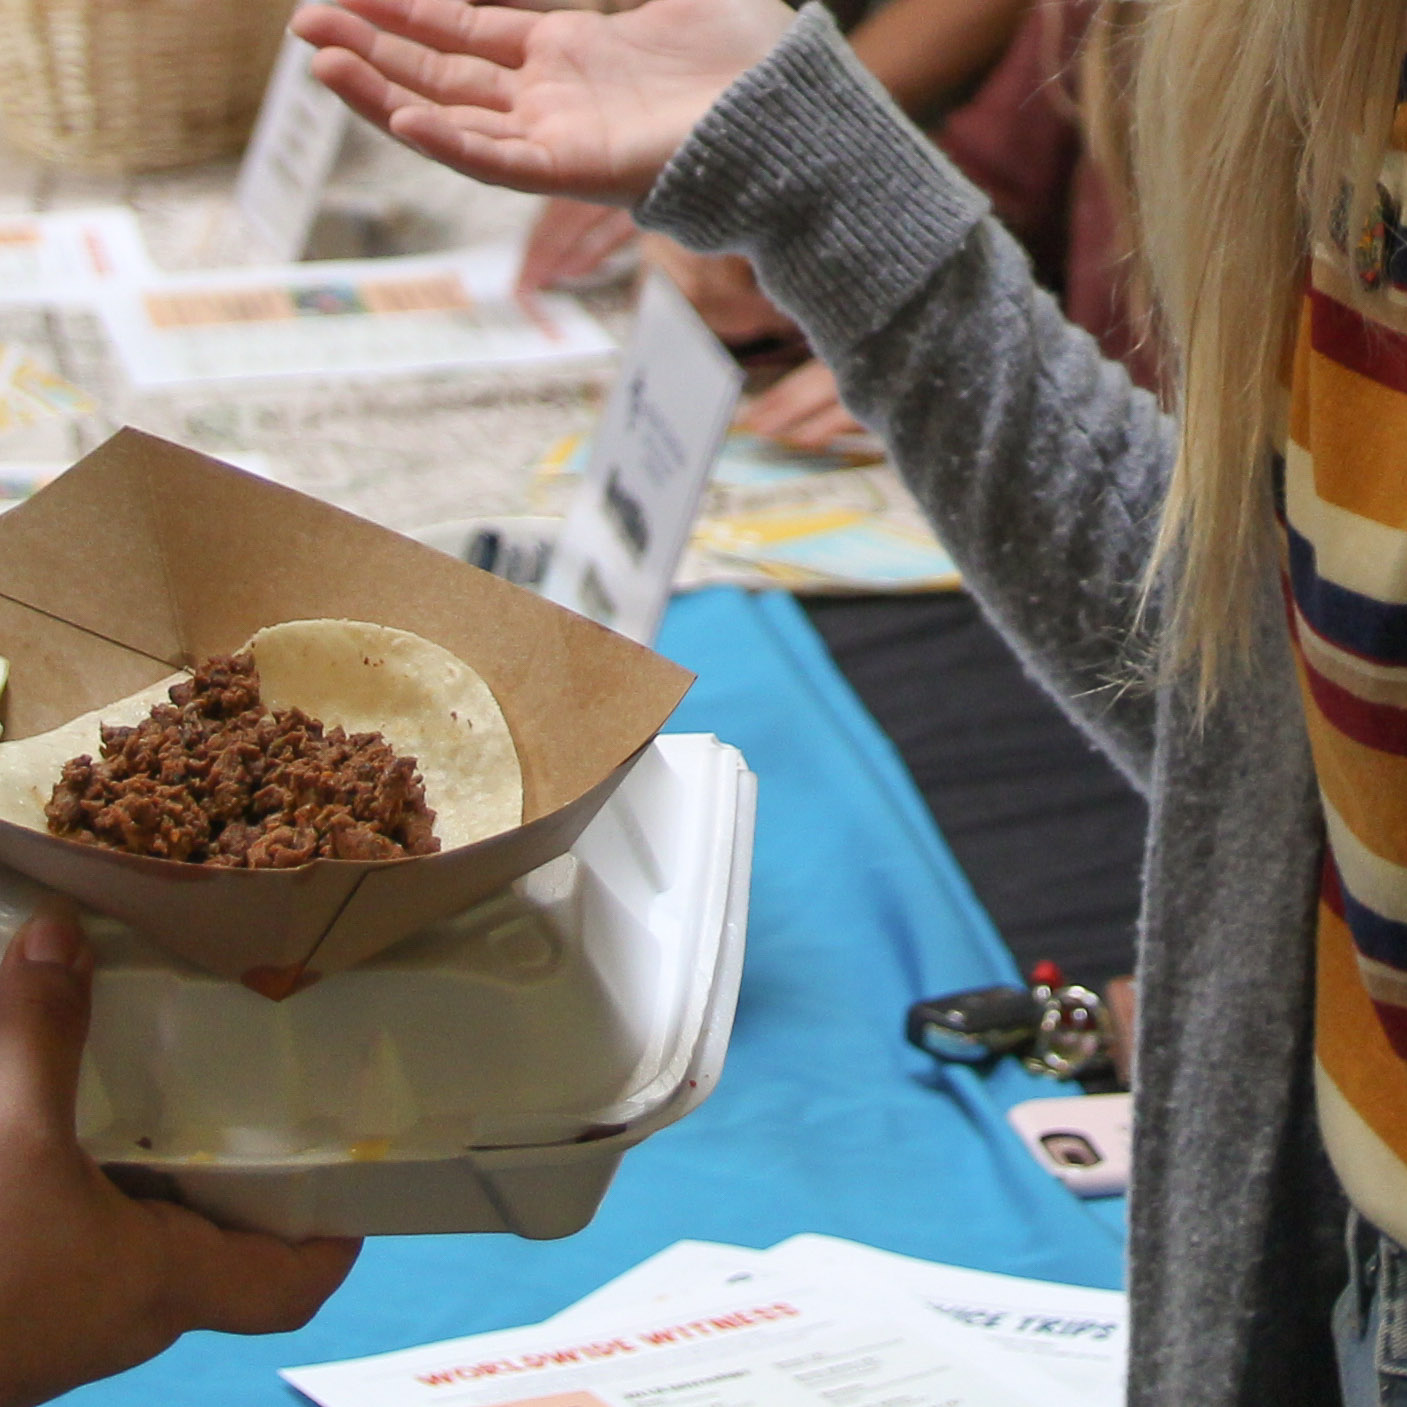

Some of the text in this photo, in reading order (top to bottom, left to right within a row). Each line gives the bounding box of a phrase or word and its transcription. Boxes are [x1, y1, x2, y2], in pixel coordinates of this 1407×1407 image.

[415, 1335, 638, 1388] WORLDWIDE
[639, 1301, 801, 1347] WITNESS
[1016, 1314, 1119, 1340] TRIPS
